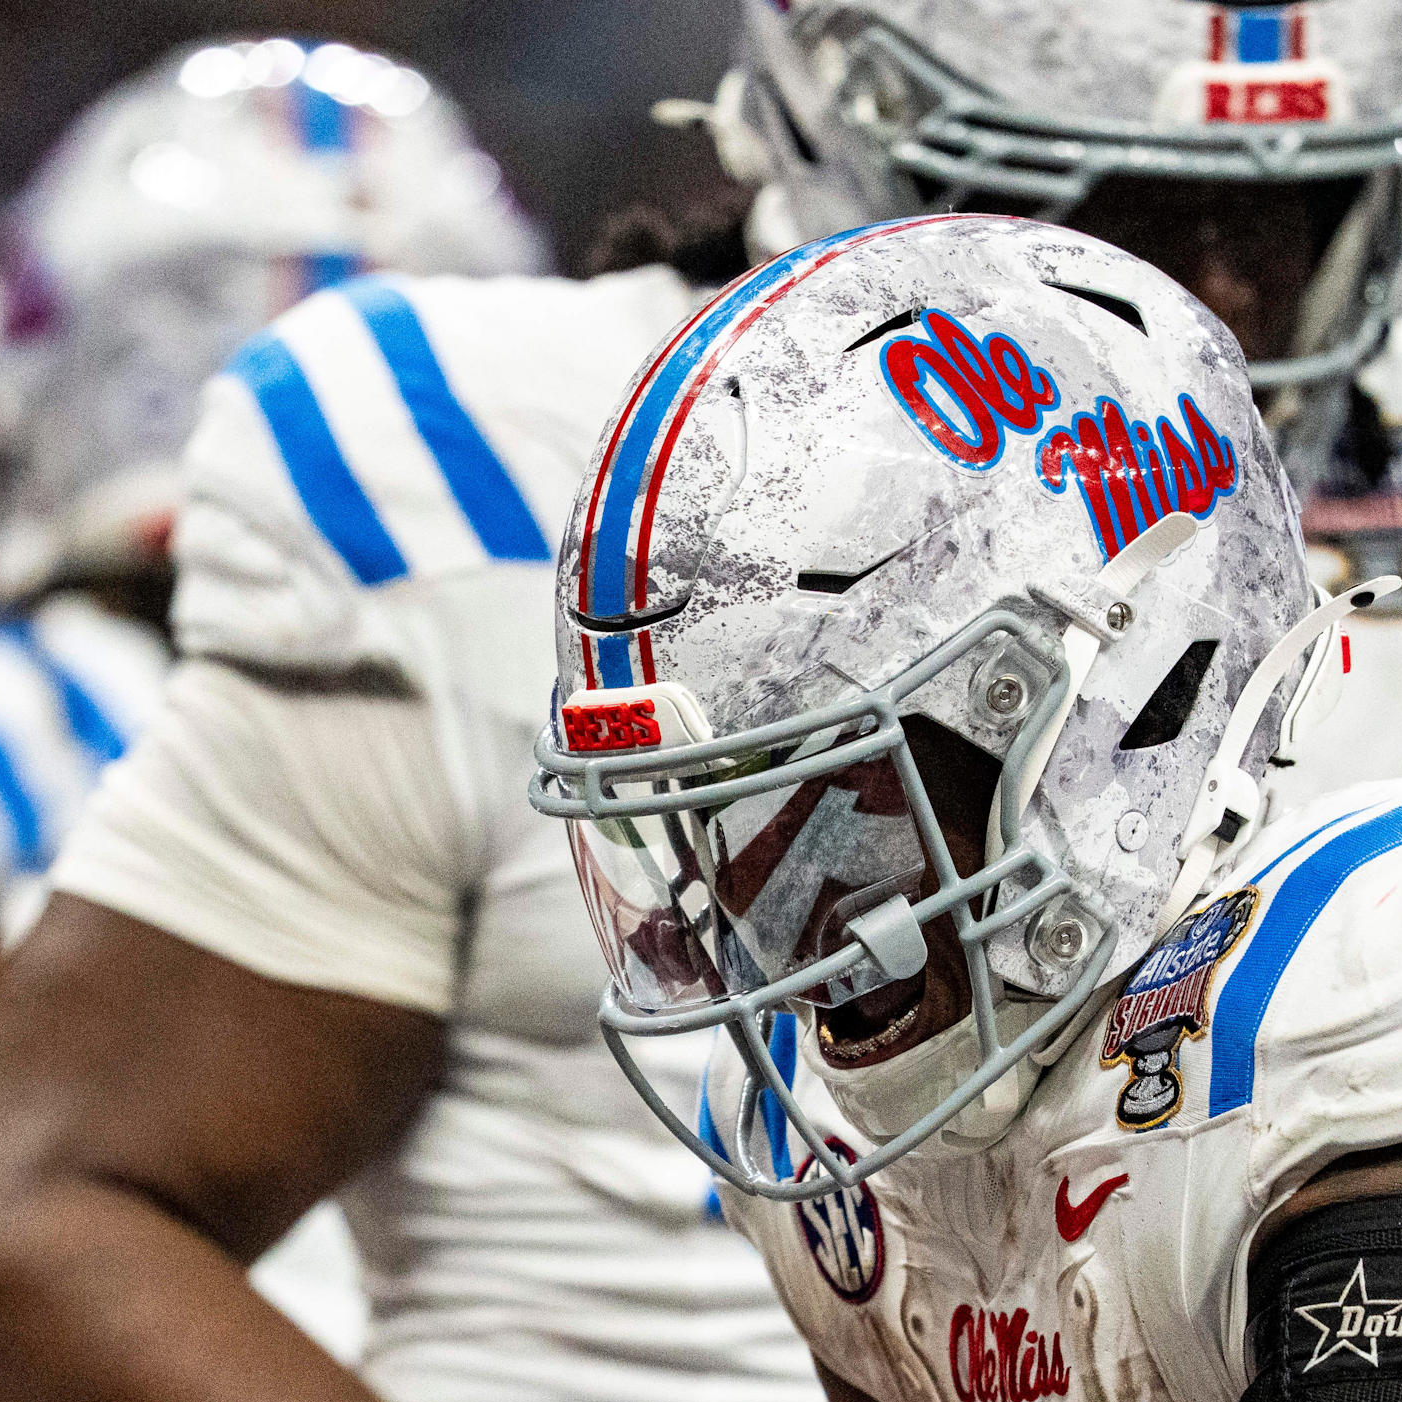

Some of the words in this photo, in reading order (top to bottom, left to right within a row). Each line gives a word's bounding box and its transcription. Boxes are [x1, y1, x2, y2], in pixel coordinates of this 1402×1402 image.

[880, 308, 1061, 470] Ole
[1036, 393, 1238, 565] Miss
[561, 698, 662, 751] REBS
